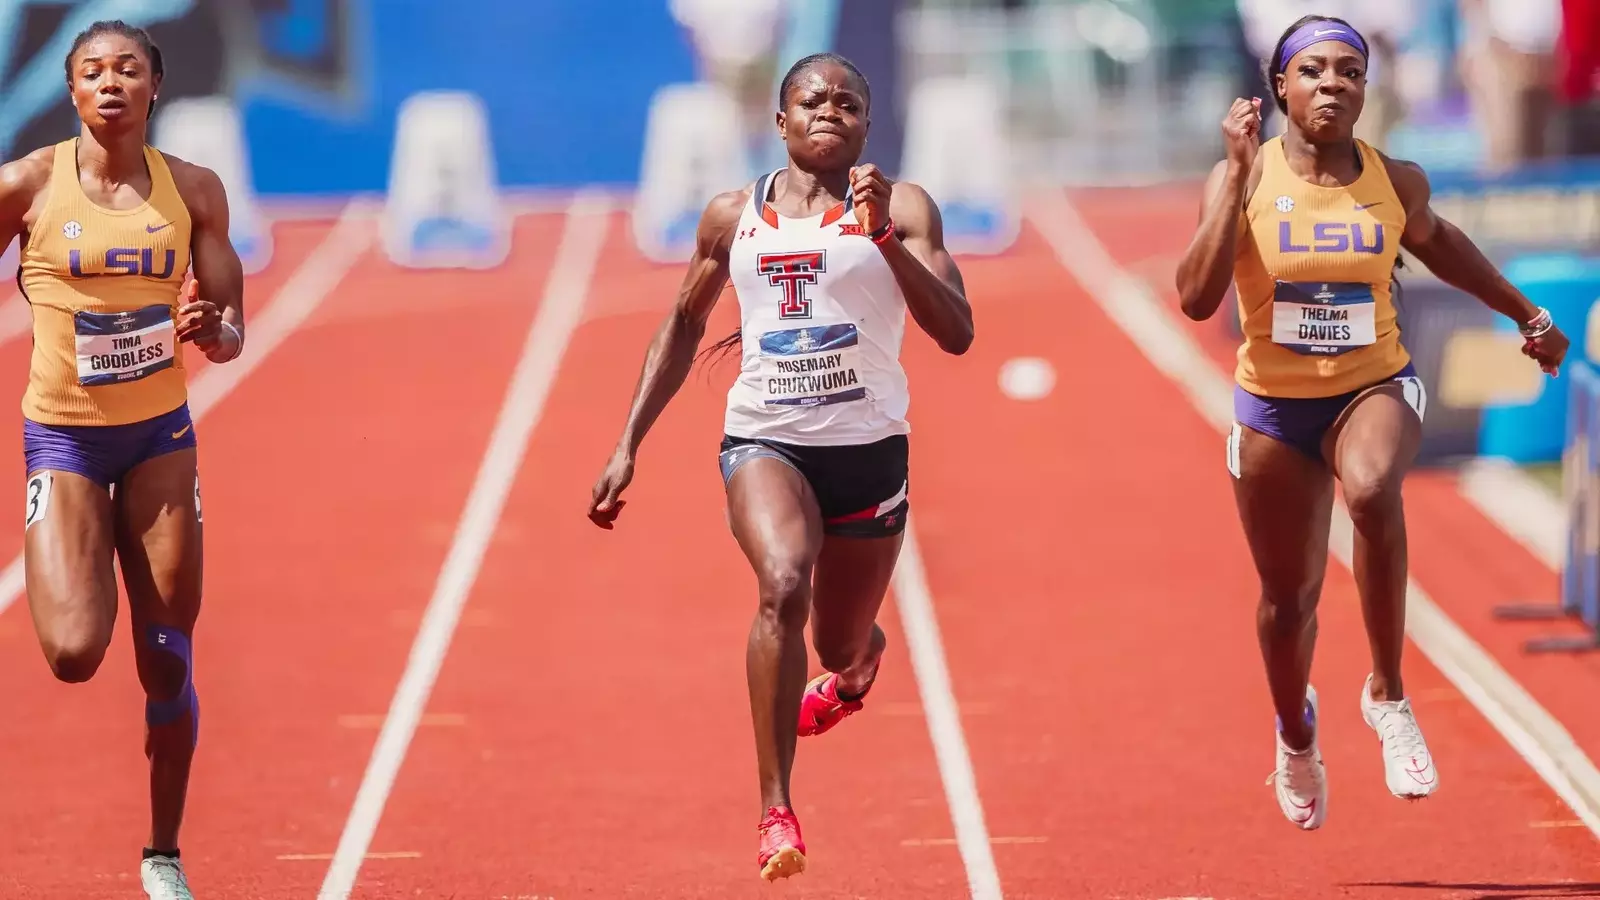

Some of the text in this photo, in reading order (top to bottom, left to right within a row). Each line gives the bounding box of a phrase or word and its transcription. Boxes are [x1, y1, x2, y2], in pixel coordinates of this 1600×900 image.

[1279, 221, 1384, 255] LSU
[69, 247, 176, 279] LSU
[1301, 307, 1348, 321] THELMA
[112, 335, 142, 350] TIMA
[1298, 324, 1351, 341] DAVIES
[91, 342, 164, 370] GODBLESS
[777, 354, 842, 374] ROSEMARY
[768, 368, 859, 395] CHUKWUMA
[27, 478, 42, 525] 3
[158, 632, 167, 644] KT
